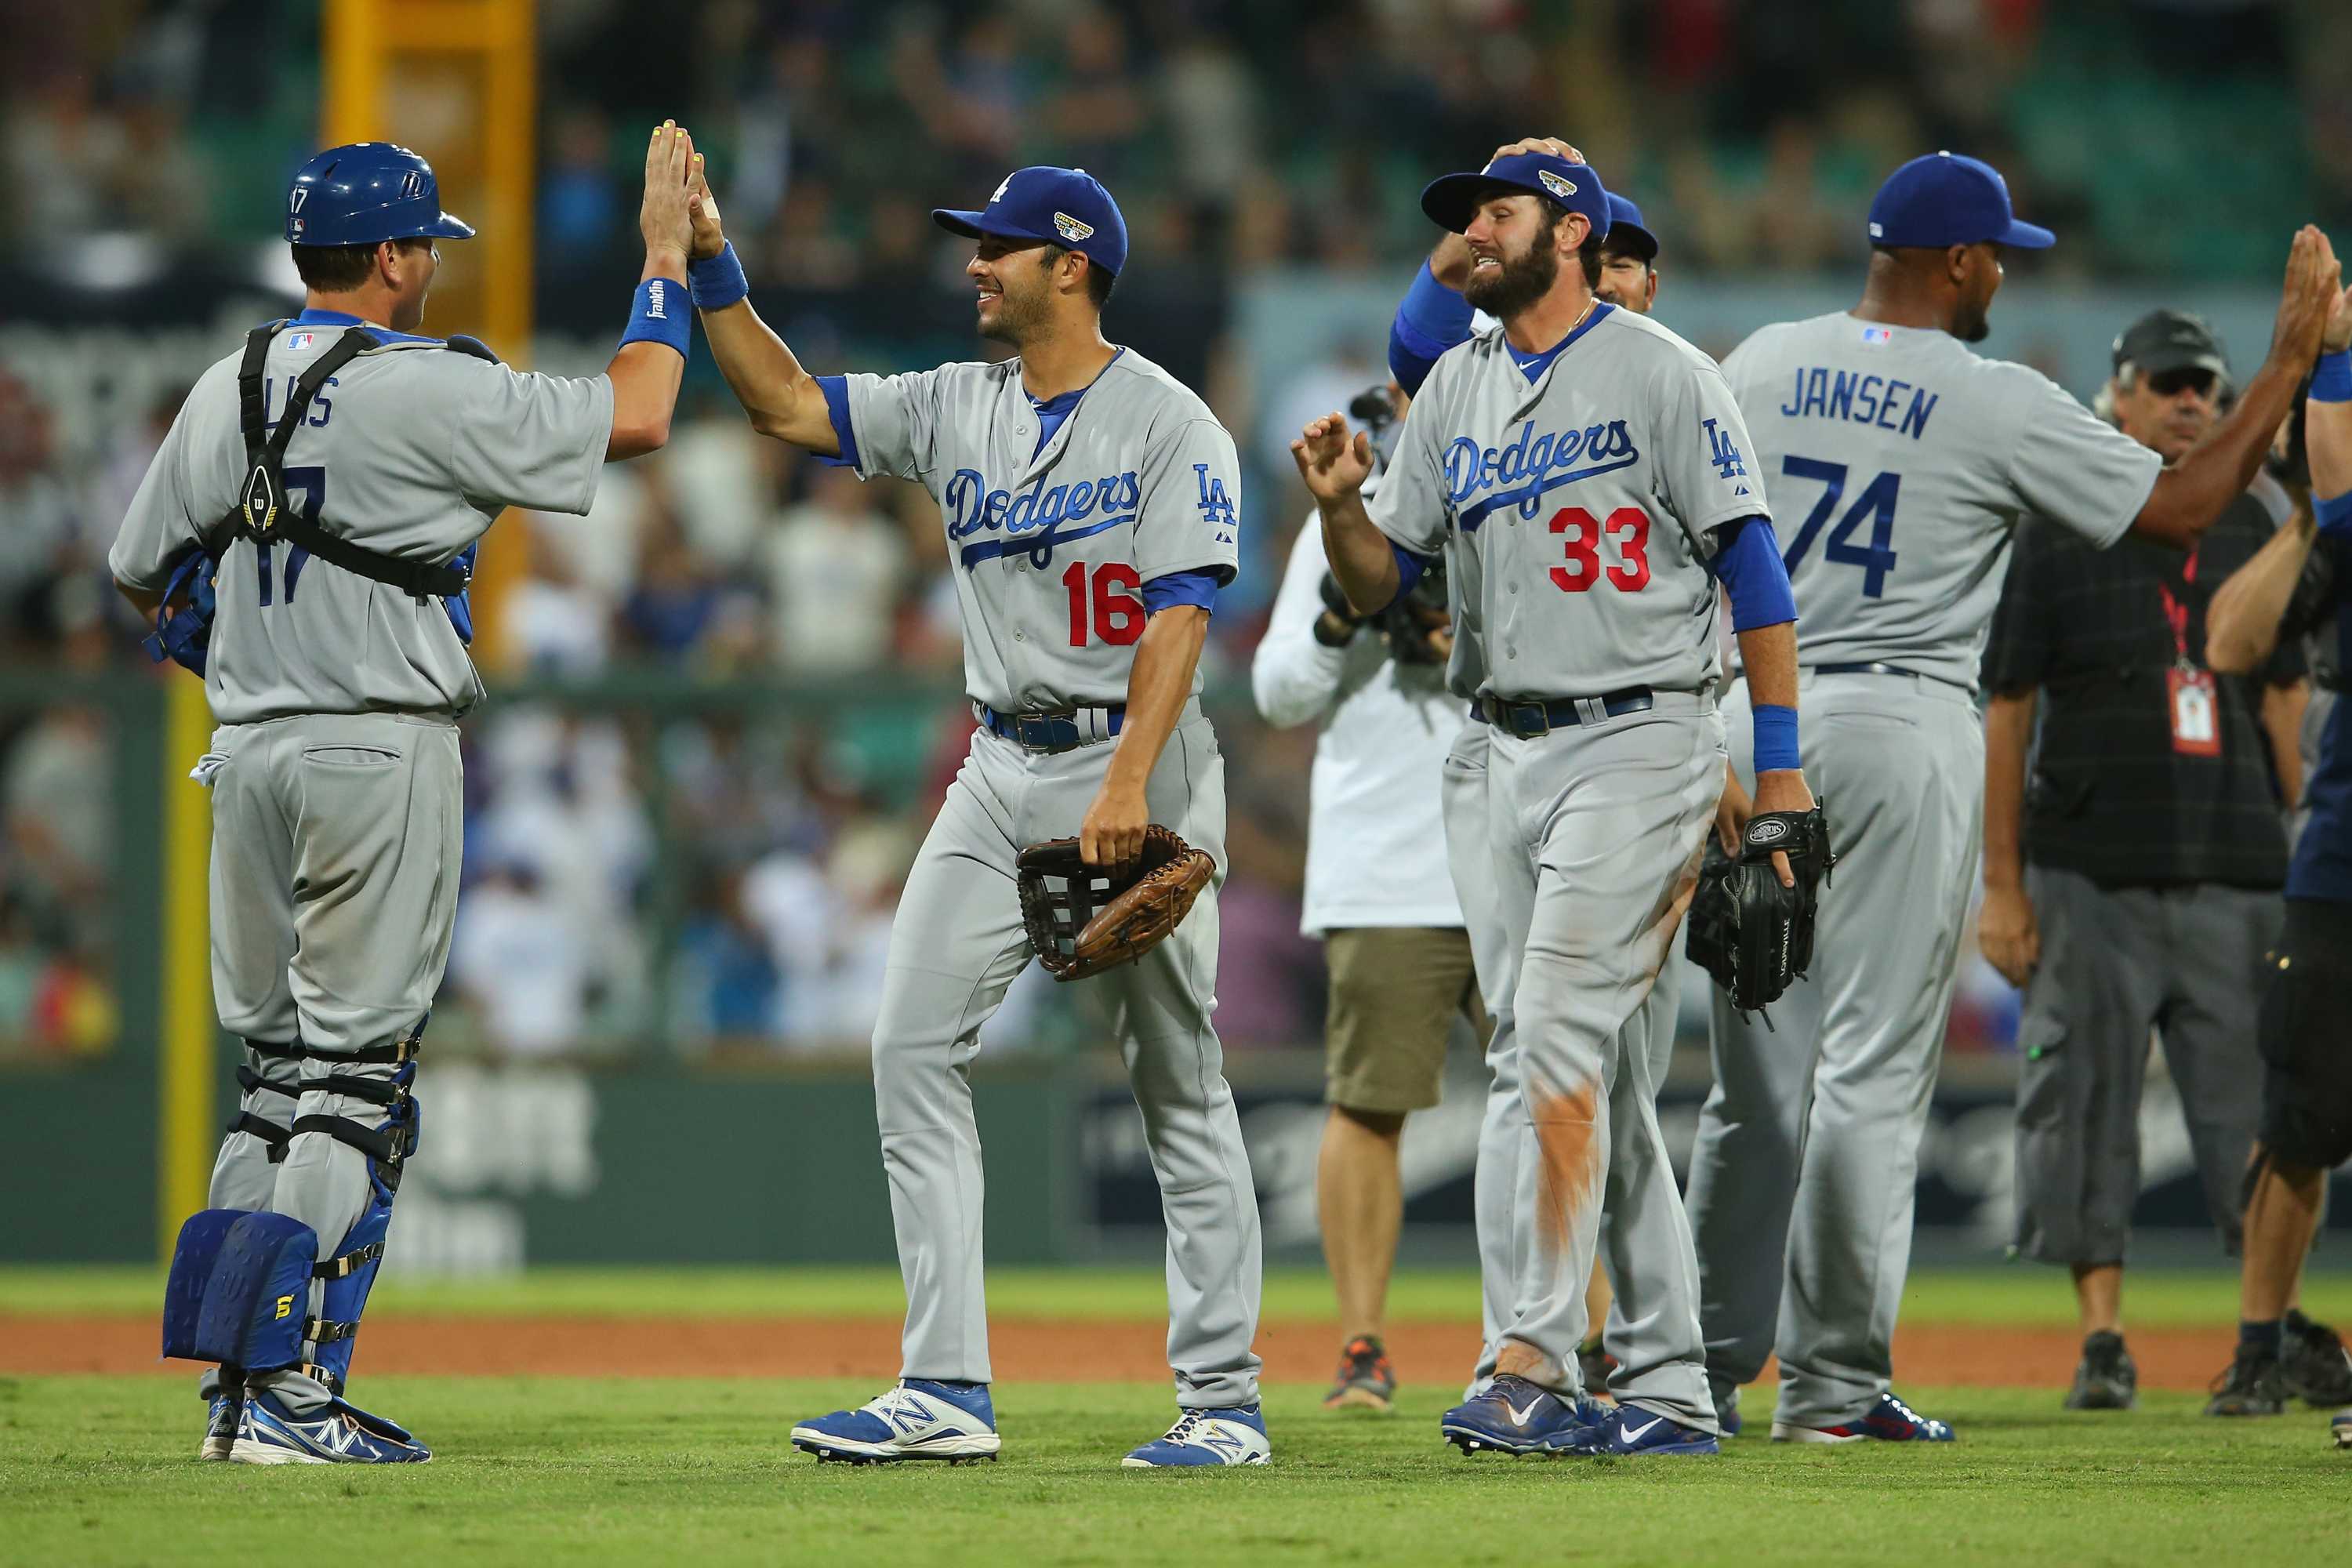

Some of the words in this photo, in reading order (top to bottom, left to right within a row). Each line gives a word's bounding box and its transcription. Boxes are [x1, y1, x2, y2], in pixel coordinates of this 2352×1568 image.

[291, 187, 308, 214] 17
[646, 280, 667, 320] franklin
[1781, 368, 1939, 440] JANSEN
[1443, 419, 1639, 525] Dodgers
[1702, 418, 1748, 479] LA
[946, 469, 1141, 571] Dodgers
[1192, 463, 1236, 526] LA
[1782, 455, 1901, 598] 74
[1549, 507, 1650, 592] 33
[1062, 561, 1146, 647] 16
